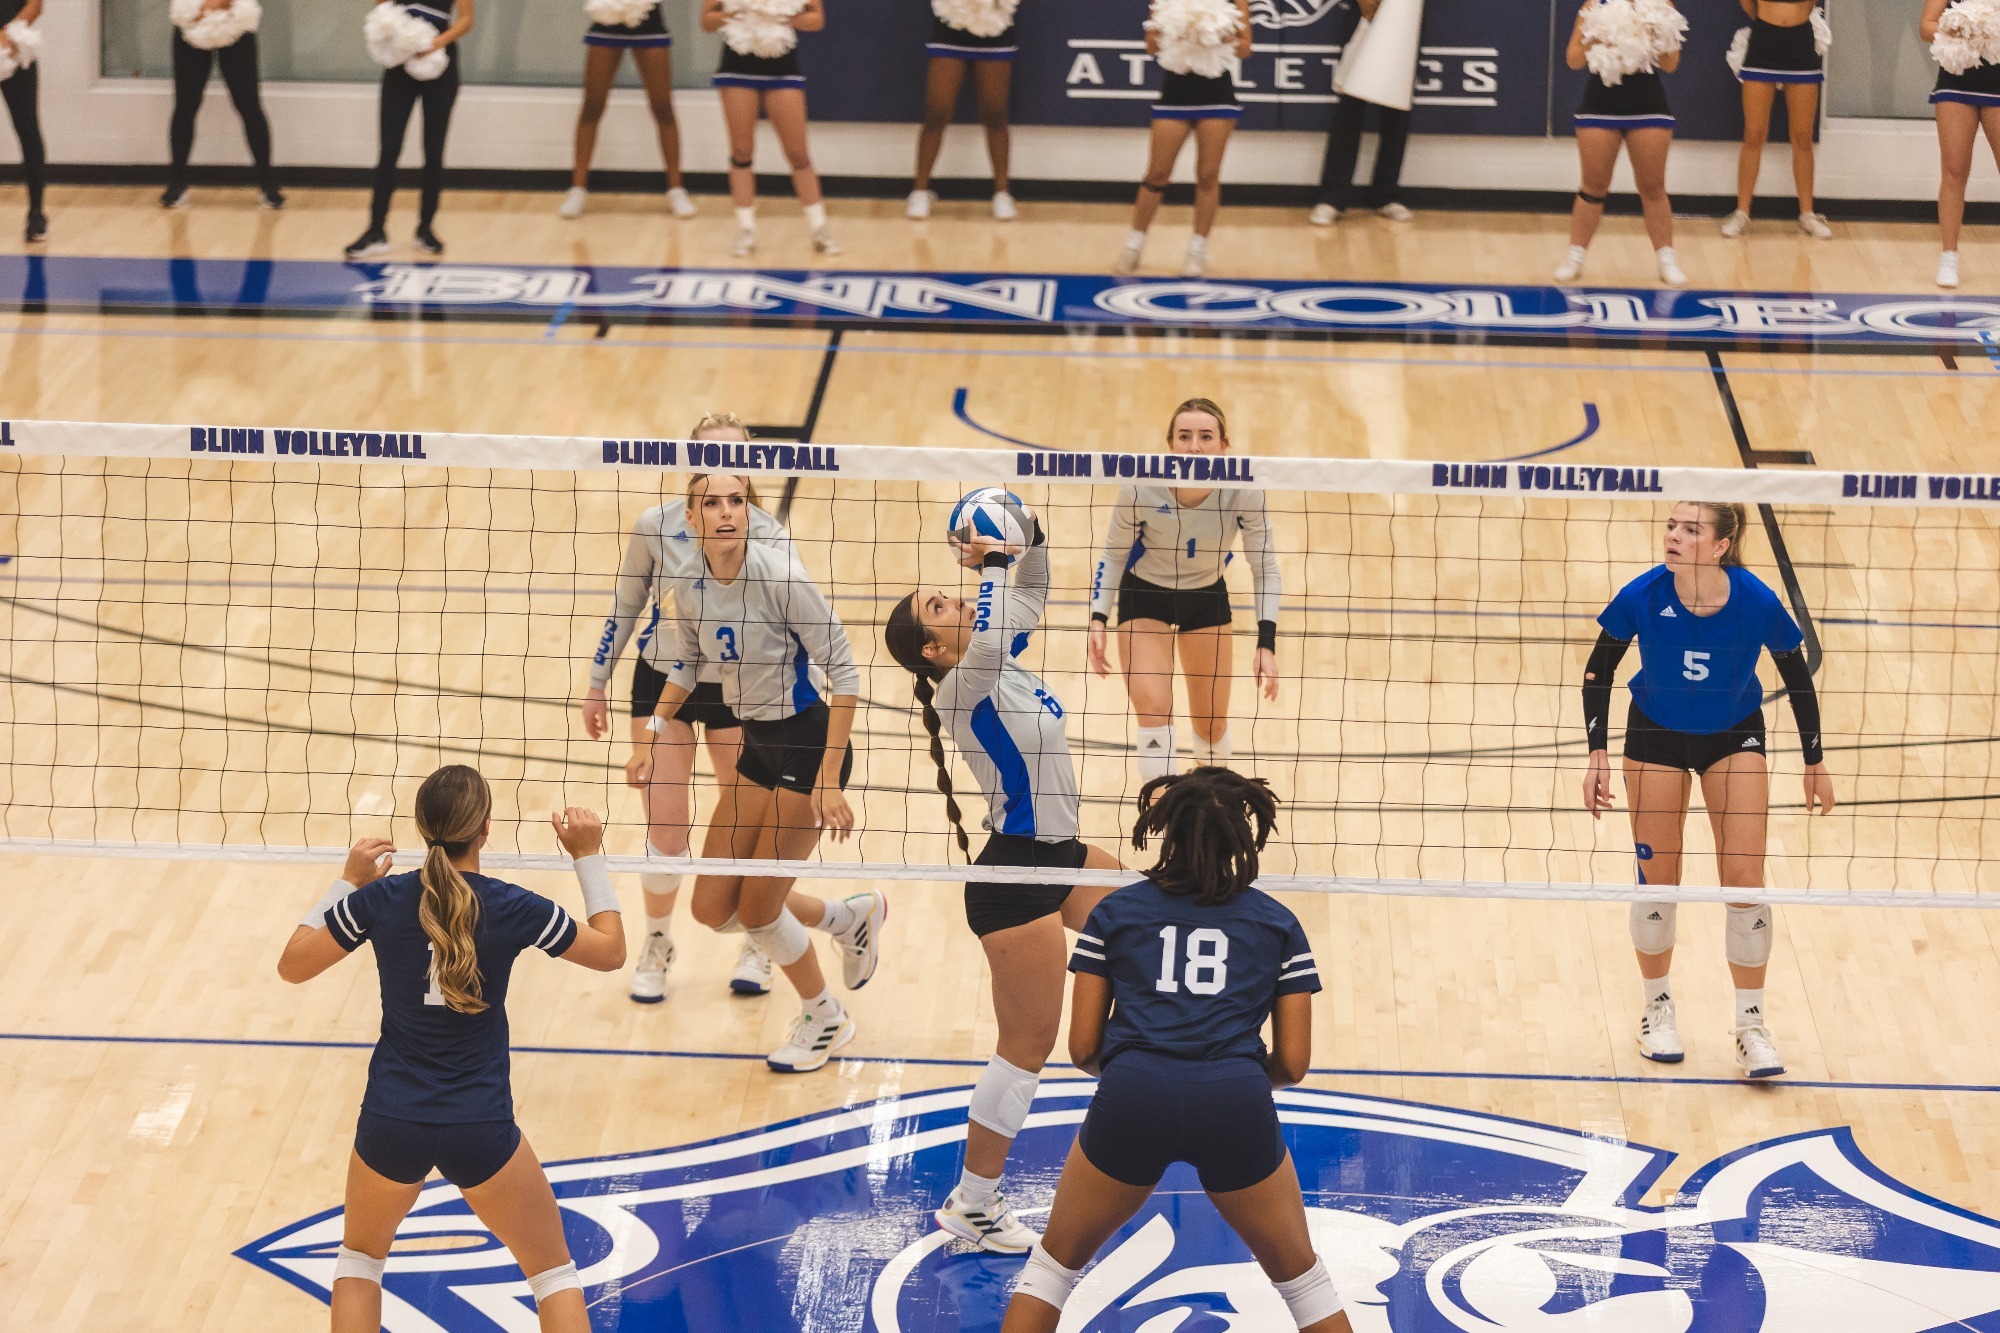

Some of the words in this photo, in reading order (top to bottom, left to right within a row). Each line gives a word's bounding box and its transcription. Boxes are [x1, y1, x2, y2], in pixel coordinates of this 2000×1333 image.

[1066, 52, 1498, 92] ATLECS
[354, 263, 1056, 321] BLINN
[190, 427, 264, 454] BLINN
[275, 430, 427, 460] VOLLEYBALL
[603, 440, 677, 465] BLINN
[687, 442, 840, 472] VOLLEYBALL
[1017, 453, 1092, 477] BLINN
[1102, 454, 1254, 482] VOLLEYBALL
[1432, 464, 1507, 489] BLINN
[1843, 474, 1917, 498] BLINN
[1186, 538, 1196, 558] 1
[715, 626, 740, 661] 3
[1682, 650, 1711, 681] 5
[1155, 925, 1229, 995] 18
